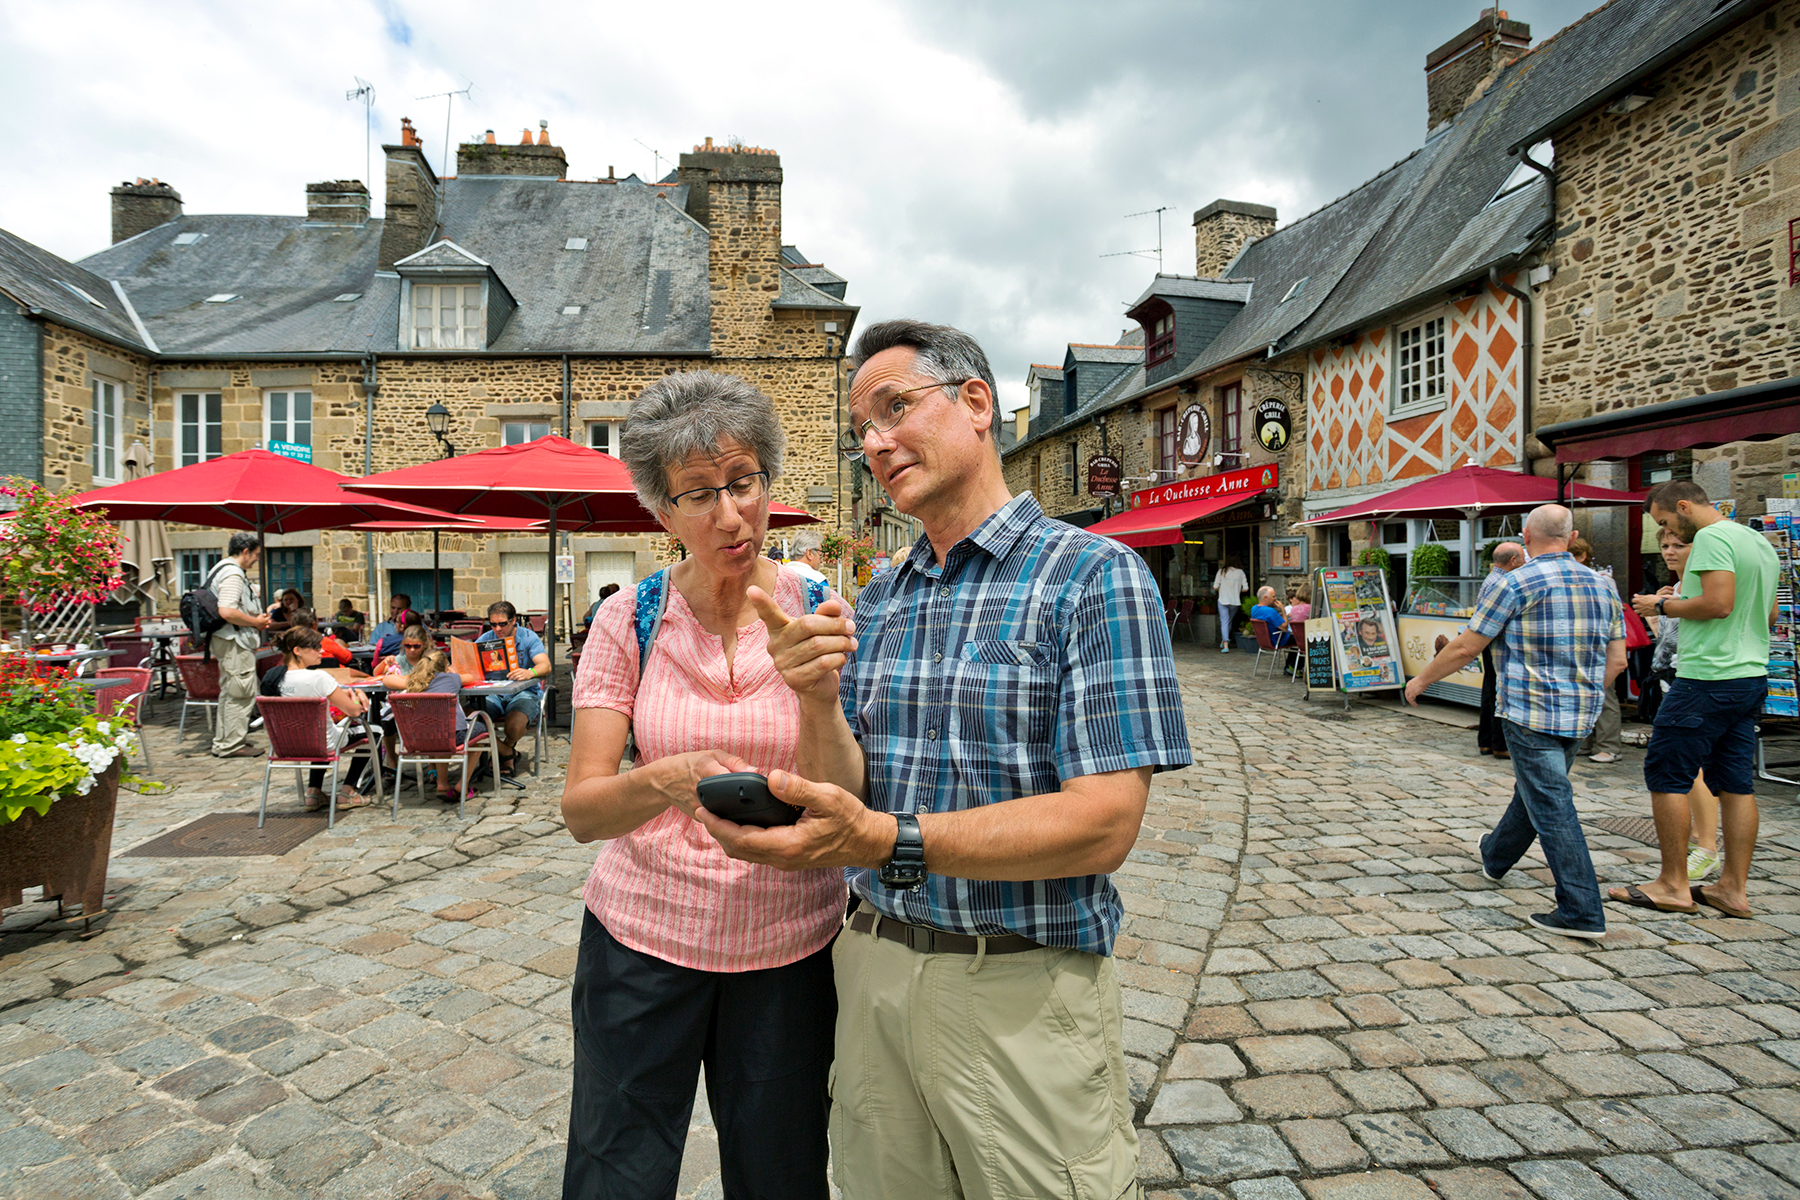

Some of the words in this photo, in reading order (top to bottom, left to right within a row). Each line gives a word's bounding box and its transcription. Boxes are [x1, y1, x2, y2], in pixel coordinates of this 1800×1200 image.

[1264, 411, 1281, 419] GRILL
[281, 444, 311, 453] VENDRE
[1091, 475, 1118, 483] Duchesse
[1149, 491, 1160, 505] La
[1163, 484, 1211, 501] Duchesse
[1216, 477, 1249, 493] Anne
[1406, 641, 1426, 652] CARTE
